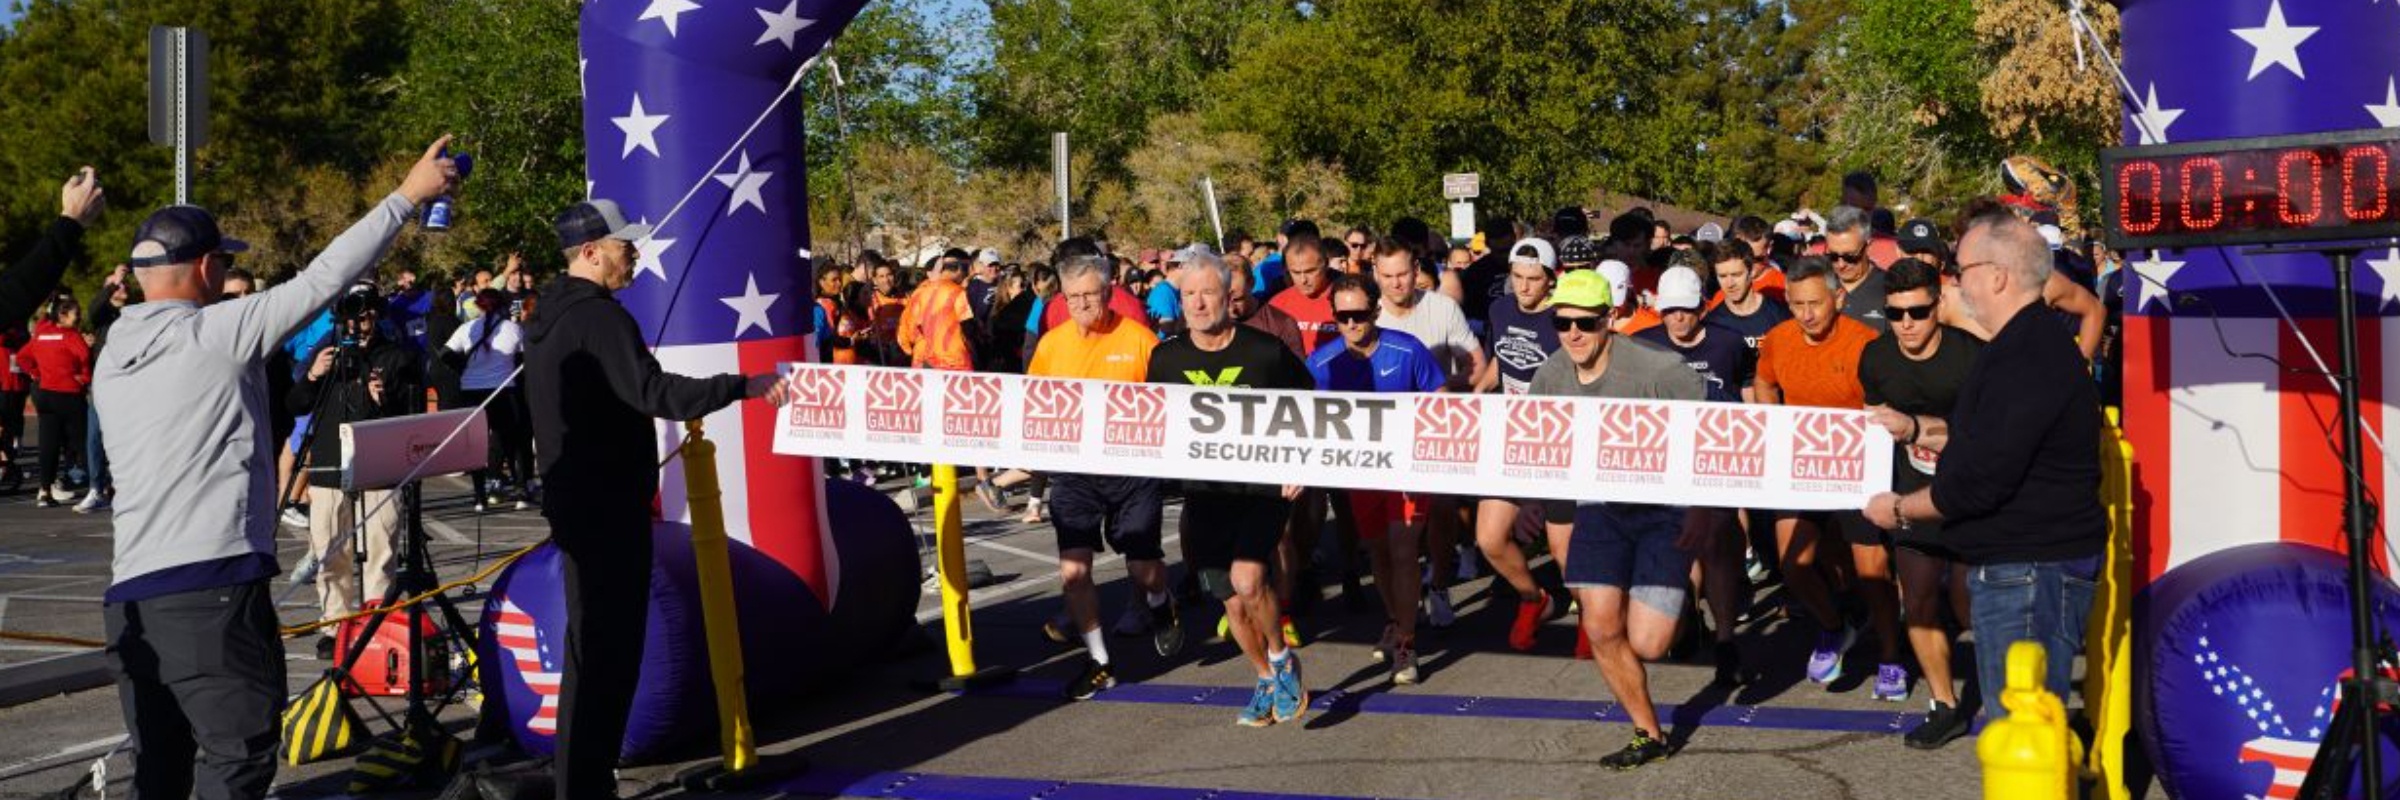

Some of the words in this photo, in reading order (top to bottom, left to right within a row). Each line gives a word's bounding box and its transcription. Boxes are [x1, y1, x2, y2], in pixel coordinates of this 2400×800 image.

[2119, 145, 2388, 235] 00:00
[792, 406, 844, 427] GALAXY
[867, 411, 920, 432] GALAXY
[945, 415, 1000, 437] GALAXY
[1189, 391, 1396, 442] START
[1023, 419, 1080, 440] GALAXY
[1106, 423, 1164, 445] GALAXY
[1188, 441, 1312, 465] SECURITY
[1321, 449, 1394, 469] 5K/2K
[1415, 440, 1478, 461] GALAXY
[1505, 444, 1570, 465] GALAXY
[1600, 449, 1665, 471] GALAXY
[1695, 453, 1763, 475] GALAXY
[1794, 458, 1863, 479] GALAXY
